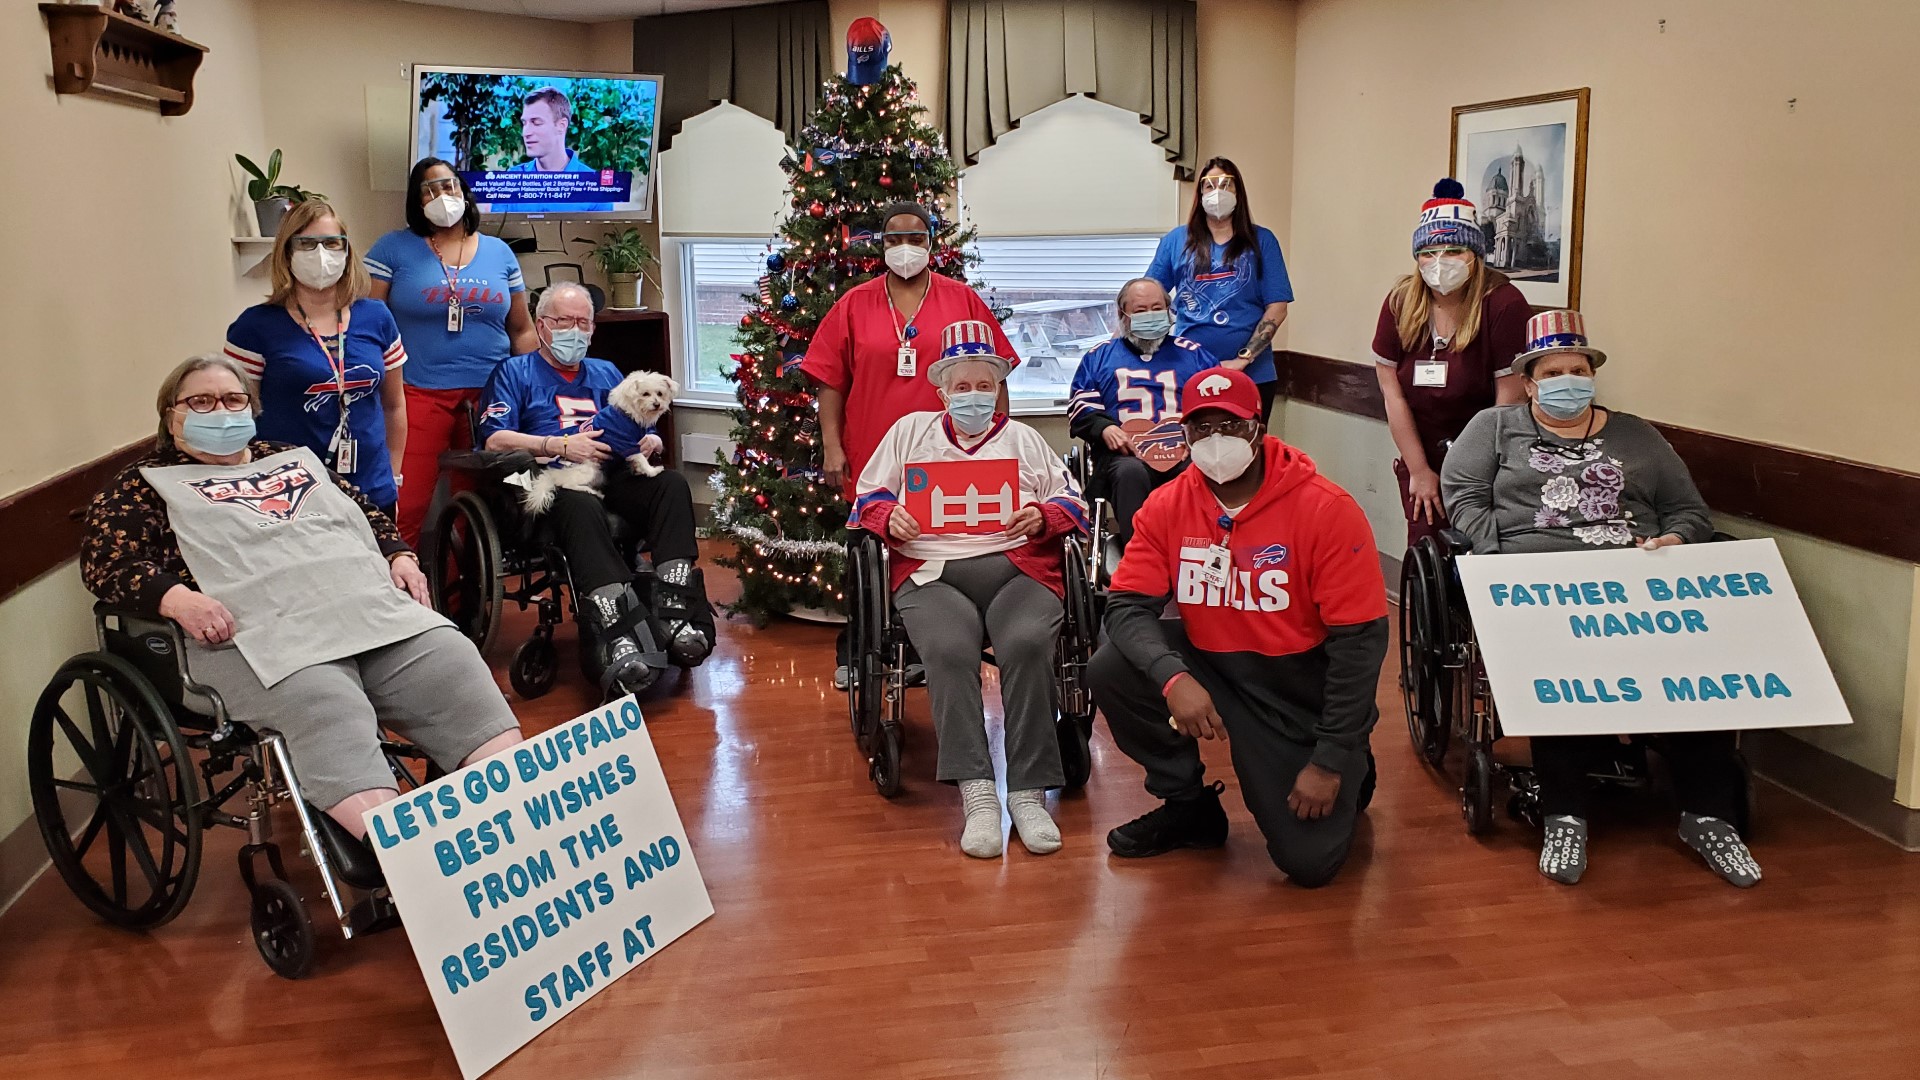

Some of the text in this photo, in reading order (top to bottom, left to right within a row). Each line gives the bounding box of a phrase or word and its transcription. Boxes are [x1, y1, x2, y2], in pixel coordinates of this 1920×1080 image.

[441, 278, 488, 286] BFFALO
[1115, 368, 1183, 422] 51
[203, 468, 310, 500] EAST
[907, 467, 929, 493] D
[1177, 561, 1290, 612] BILLS
[1489, 572, 1773, 607] FATHER BAKER
[1569, 609, 1709, 638] MANOR
[1533, 672, 1793, 704] BILLS MAFIA
[373, 701, 643, 850] LETS GO BUFFALO
[434, 753, 637, 877] BEST WISHES
[463, 813, 624, 919] FROM THE
[441, 835, 681, 995] RESIDENTS AND
[524, 914, 657, 1023] STAFF AT
